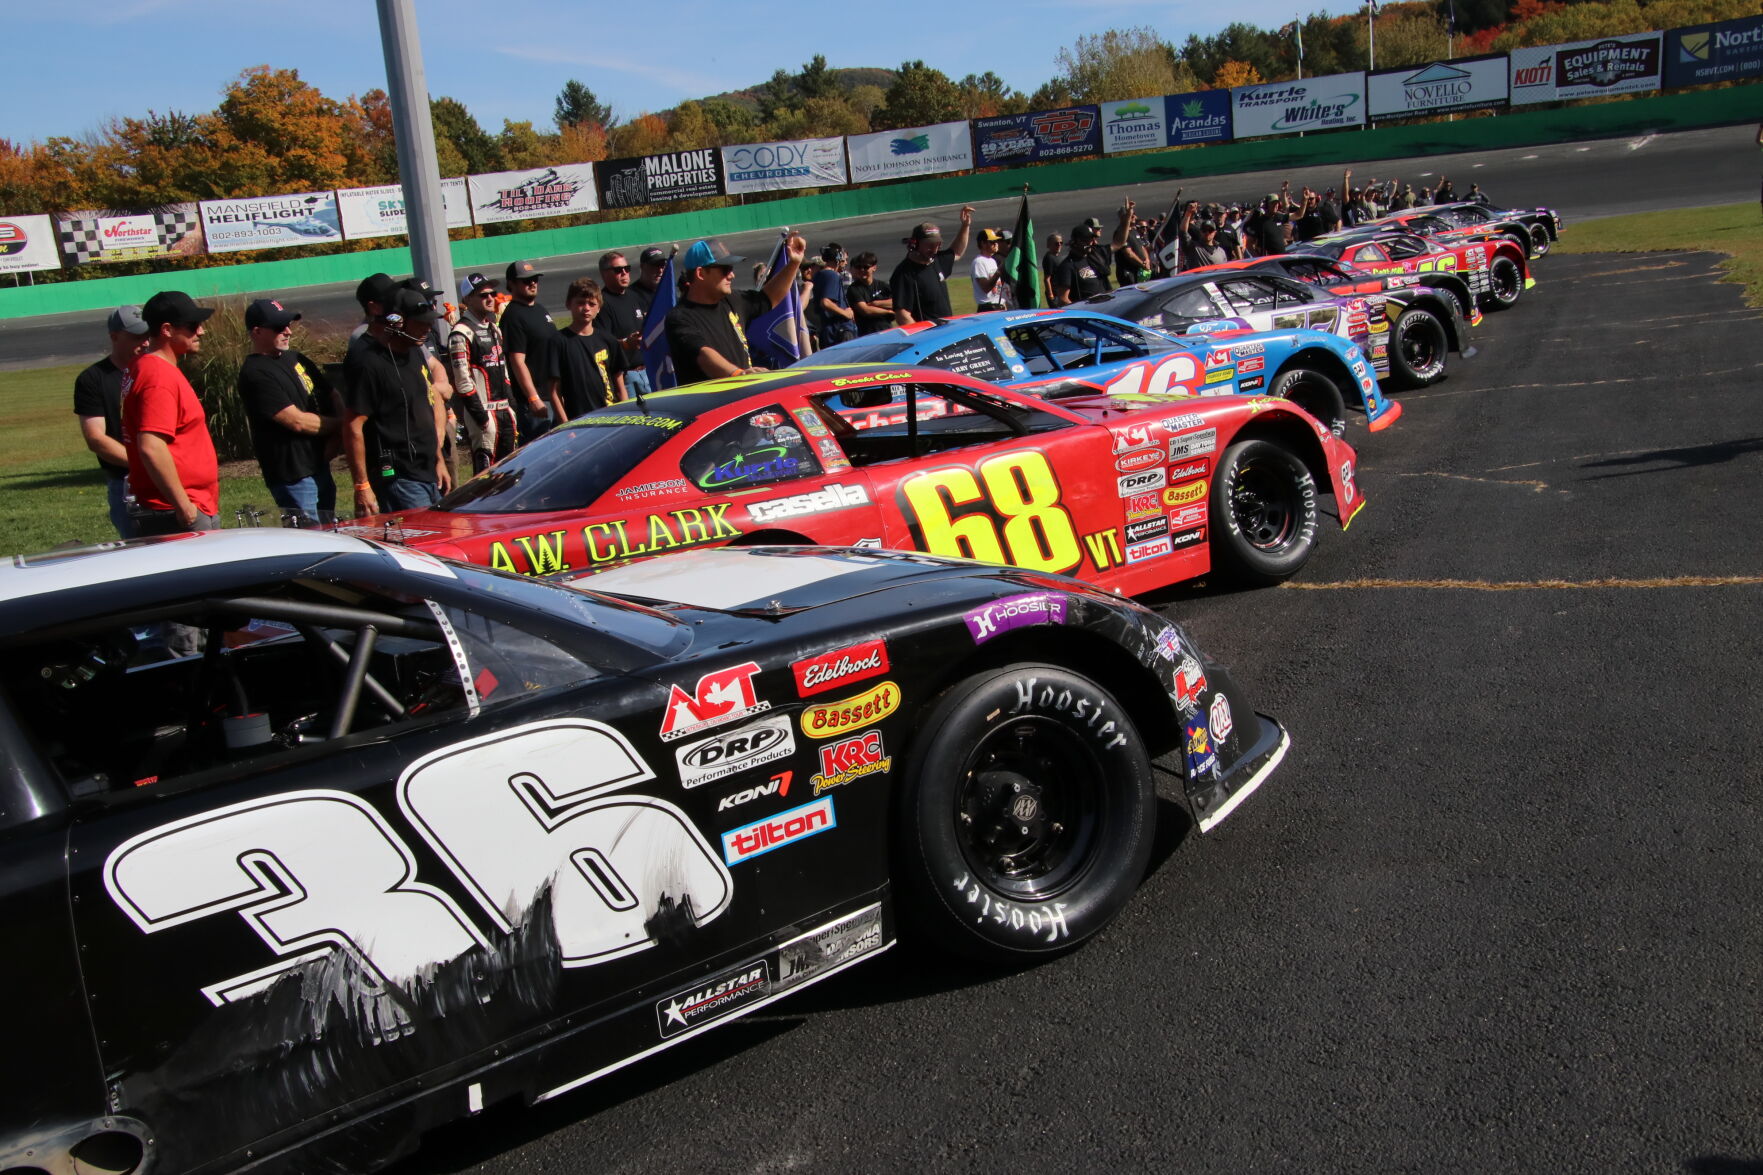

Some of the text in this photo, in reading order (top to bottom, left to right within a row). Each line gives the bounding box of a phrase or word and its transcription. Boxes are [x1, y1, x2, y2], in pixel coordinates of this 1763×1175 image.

[1714, 24, 1763, 48] Nort
[1564, 48, 1650, 70] EQUIPMENT
[1514, 66, 1552, 85] KIOTI
[1566, 66, 1595, 81] Sales
[1596, 64, 1604, 73] &
[1607, 61, 1645, 72] Rentals
[1239, 86, 1306, 102] Kurrle
[1404, 80, 1472, 101] NOVELLO
[1239, 96, 1306, 108] TRANSPORT
[1407, 95, 1464, 109] FURNITURE
[1285, 103, 1345, 123] White's
[977, 119, 1014, 128] Swanton,
[1106, 121, 1160, 136] Thomas
[1171, 115, 1226, 136] Arandas
[1115, 133, 1155, 142] Hometown
[645, 149, 715, 175] MALONE
[733, 144, 808, 170] CODY
[855, 164, 880, 173] NOYLE
[883, 159, 921, 171] JOHNSON
[923, 153, 967, 165] INSURANCE
[648, 169, 716, 189] PROPERTIES
[734, 167, 806, 180] CHEVROLET
[534, 183, 573, 195] DARK
[649, 188, 685, 196] commercial
[679, 190, 717, 199] development
[207, 200, 301, 215] MANSFIELD
[501, 192, 572, 208] ROOFING
[209, 208, 315, 224] HELIFLIGHT
[379, 209, 406, 217] SLIDE
[104, 221, 152, 238] Northstar
[212, 228, 282, 240] 802-893-1003
[944, 351, 964, 360] Loving
[964, 346, 987, 356] Memory
[1205, 348, 1233, 369] ACT
[952, 364, 968, 374] ARRY
[969, 360, 991, 370] GREEN
[1106, 355, 1197, 395] 16
[831, 372, 912, 387] Brooks Clark
[1162, 413, 1199, 429] QUARTER
[1171, 419, 1203, 431] MASTER
[1113, 421, 1155, 453] ACT
[714, 456, 798, 481] Kurrle
[1172, 464, 1206, 479] Edelbrock
[616, 478, 687, 498] JAMIESON
[1127, 473, 1158, 487] DRP
[619, 486, 689, 502] INSURANCE
[1167, 483, 1203, 501] Bassett
[749, 483, 871, 522] casella
[903, 451, 1081, 574] 68
[1131, 494, 1158, 512] KRC
[1296, 472, 1319, 545] Hoosier
[584, 503, 742, 563] CLARK
[1134, 519, 1166, 532] ALLSTAR
[1134, 526, 1167, 536] PERFORMANCE
[1174, 531, 1201, 545] KONI
[1084, 529, 1124, 571] VT
[1129, 543, 1168, 560] tilton
[803, 649, 882, 688] Edelbrock
[661, 662, 763, 736] ACT
[812, 688, 892, 731] Bassett
[1009, 677, 1127, 750] Hoosier
[699, 728, 779, 765] DRP
[820, 731, 884, 776] KRC
[686, 747, 793, 787] Performance Products
[811, 755, 891, 796] Power Steering
[717, 779, 779, 813] KONI
[730, 809, 829, 857] tilton
[102, 717, 734, 1006] 36
[953, 872, 1069, 942] Hoosier
[681, 967, 762, 1009] ALLSTAR
[684, 981, 766, 1020] PERFORMANCE
